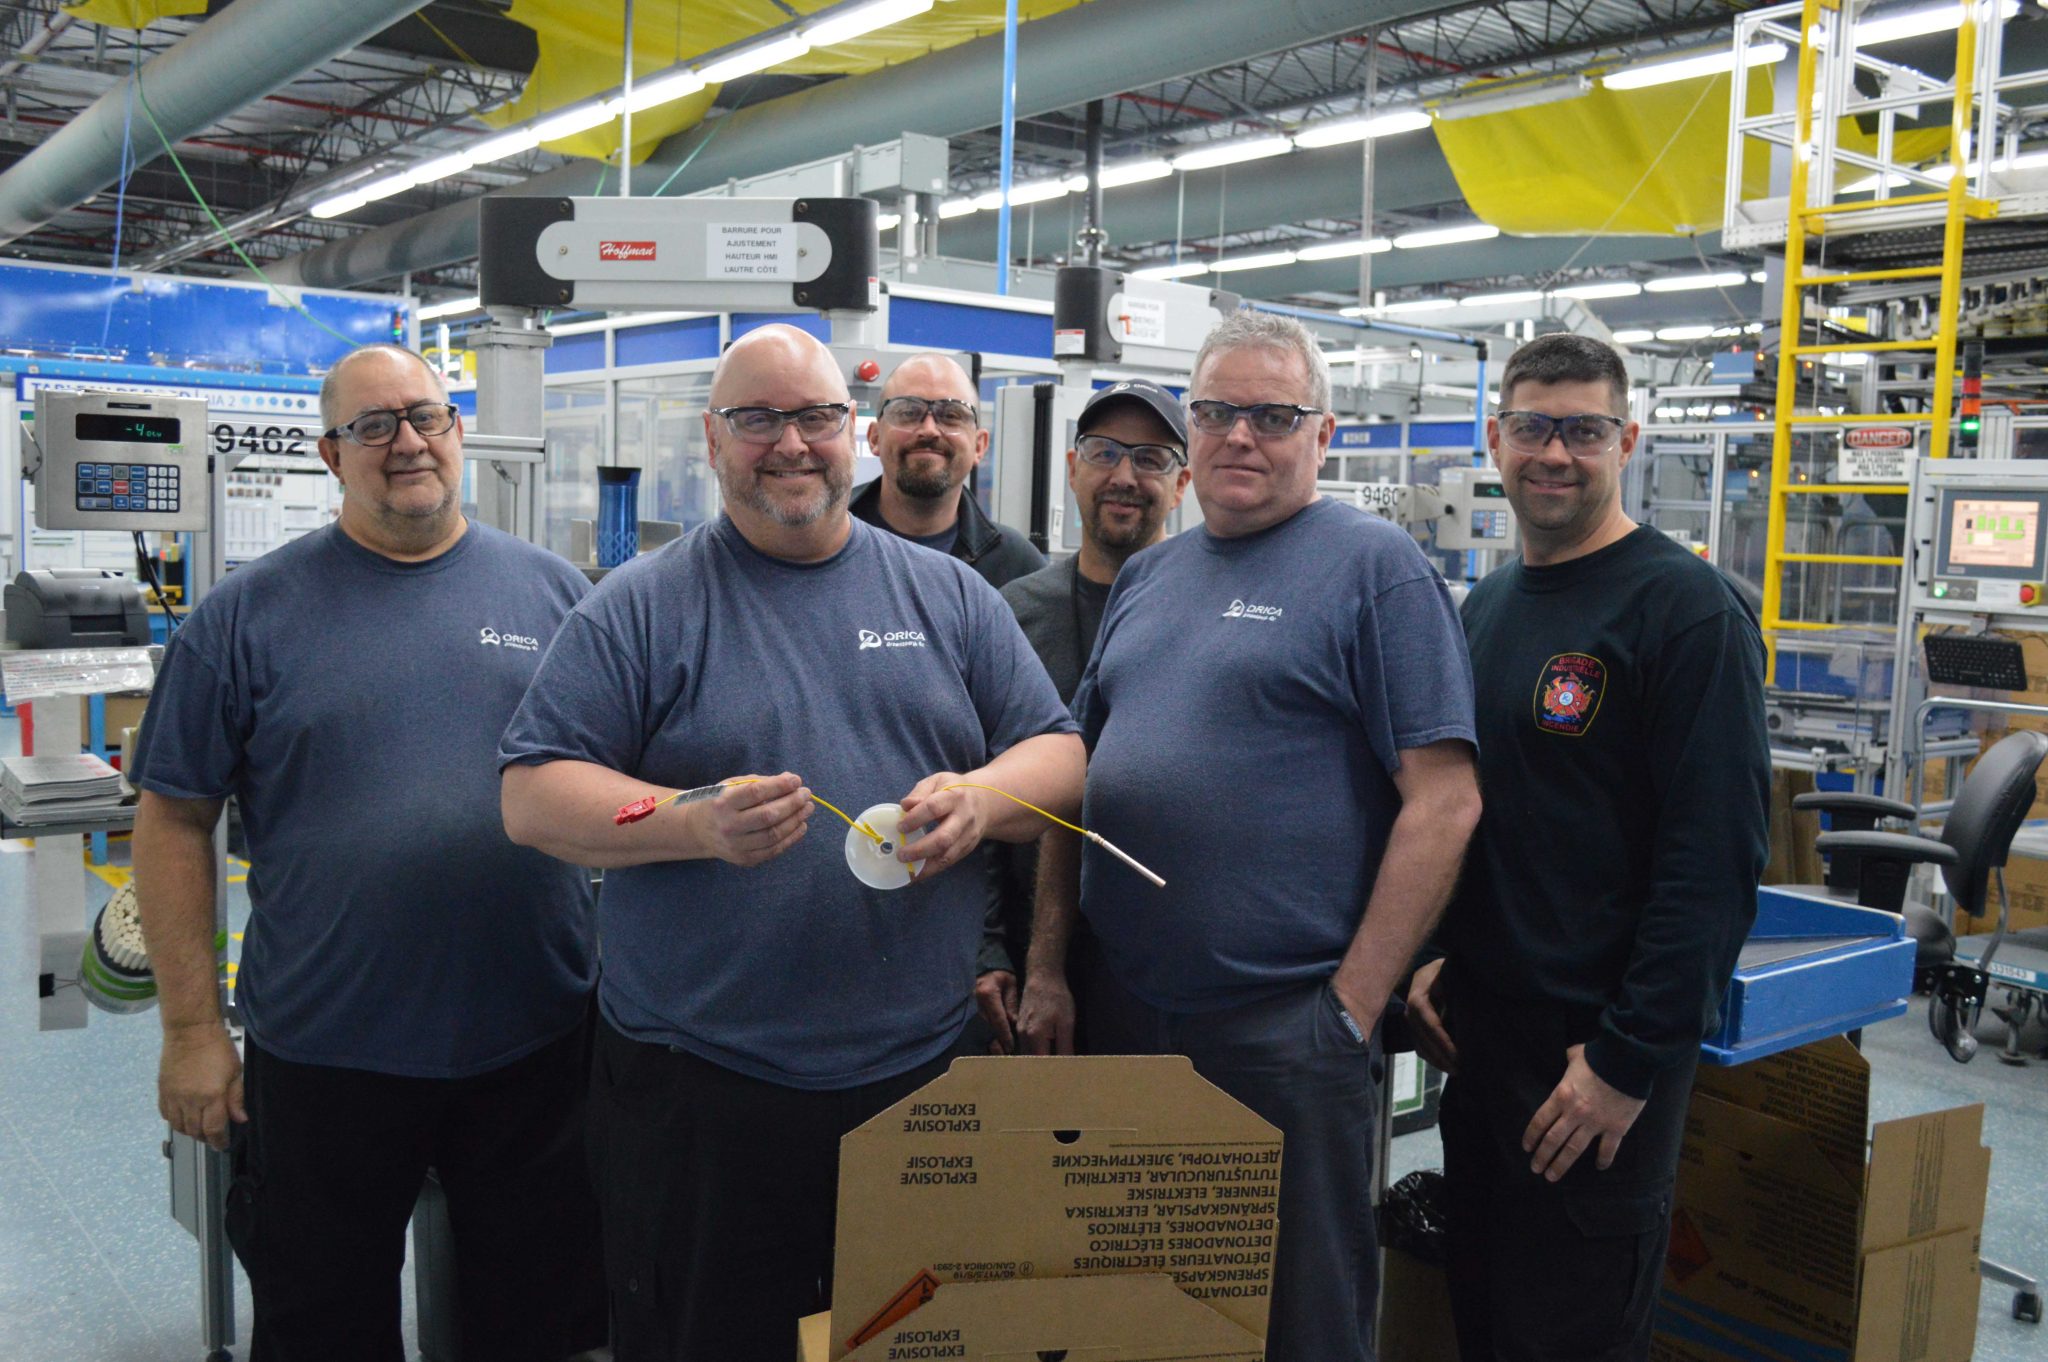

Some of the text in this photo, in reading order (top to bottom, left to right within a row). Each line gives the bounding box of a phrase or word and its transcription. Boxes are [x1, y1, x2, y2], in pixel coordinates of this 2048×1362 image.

[600, 242, 655, 260] Hoffman
[213, 423, 306, 455] 9462
[1853, 431, 1906, 445] DANGER
[1246, 604, 1283, 617] ORICA
[502, 633, 539, 646] ORICA
[884, 630, 926, 641] ORICA
[909, 1103, 976, 1116] EXPLOSIF
[903, 1119, 981, 1132] EXPLOSIVE
[906, 1156, 973, 1169] EXPLOSIF
[900, 1172, 977, 1185] EXPLOSIVE
[1127, 1185, 1277, 1200] TENNERE, ELEKTRISKE
[1065, 1205, 1149, 1218] ELEKTRISKA
[1087, 1218, 1274, 1237] DETONADORES, ELÉTRICOS
[1089, 1235, 1273, 1253] DETONADORES ELÉCTRICO
[1073, 1251, 1271, 1270] DÉTONATEURS ÉLECTRIQUES
[1168, 1268, 1269, 1283] SPRENGKAPSE
[894, 1329, 960, 1344] EXPLOSIF
[888, 1345, 965, 1360] EXPLOSIVE
